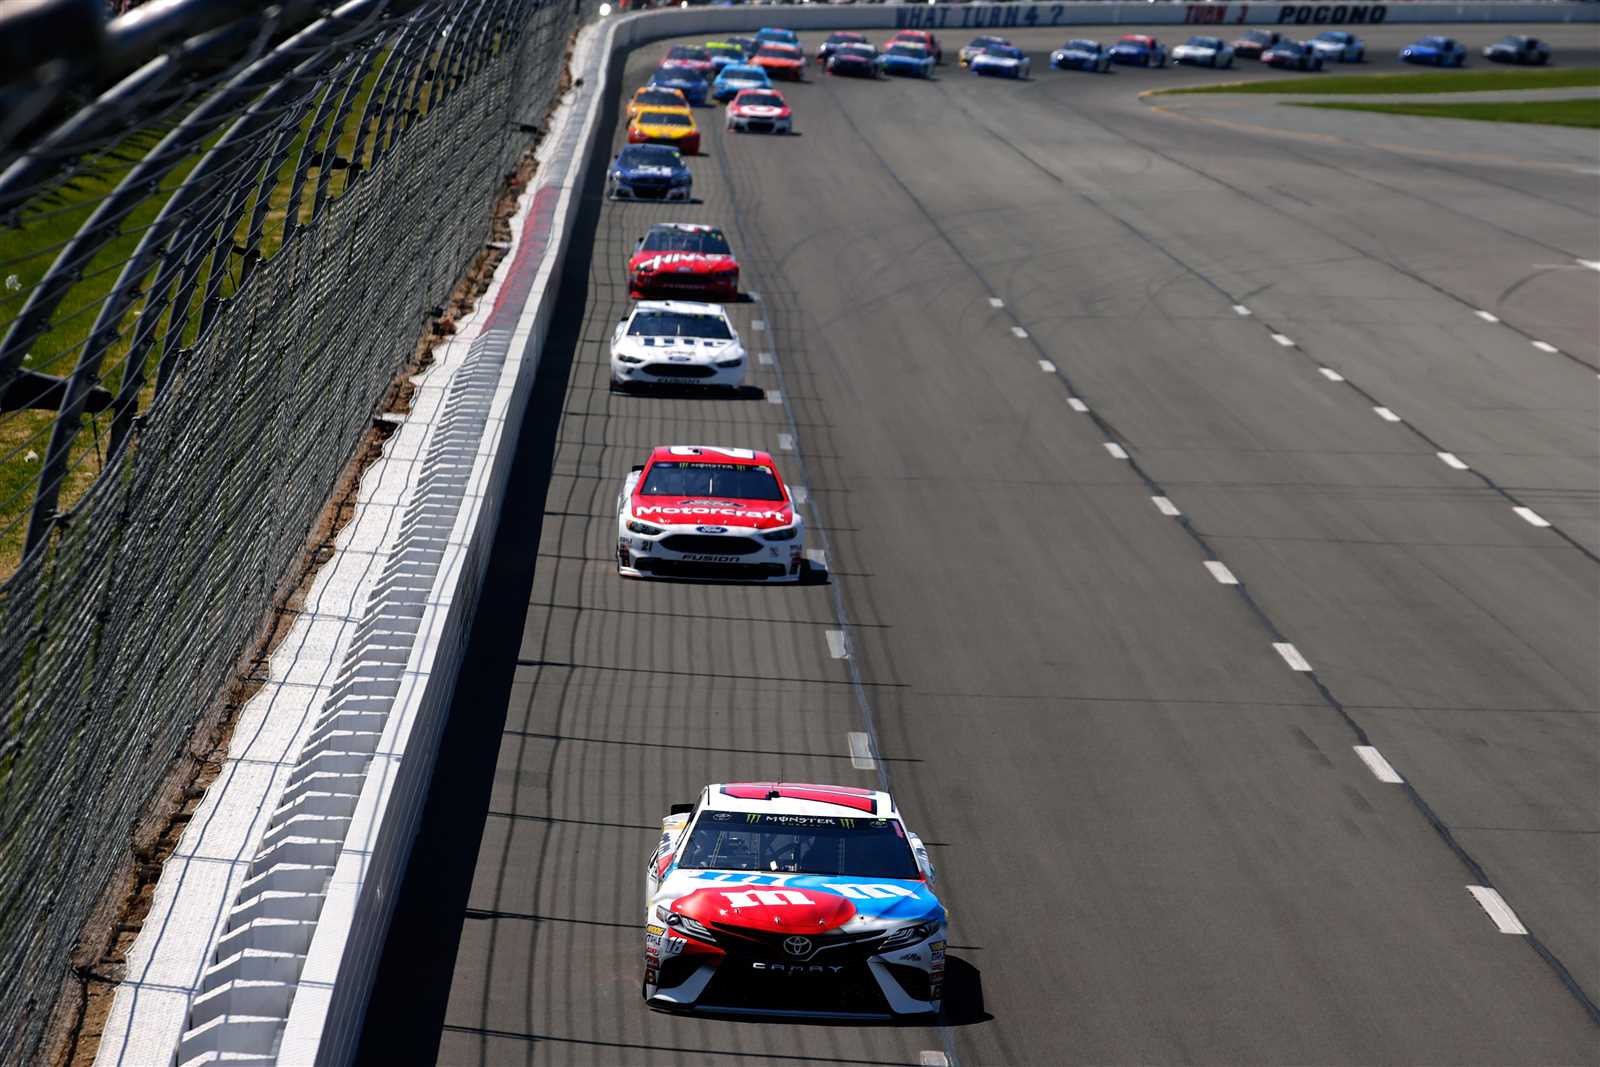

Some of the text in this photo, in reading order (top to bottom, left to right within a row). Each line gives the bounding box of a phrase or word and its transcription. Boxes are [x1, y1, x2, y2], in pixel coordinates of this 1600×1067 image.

[896, 6, 951, 28] WHAT
[961, 6, 1021, 28] TURN
[1277, 5, 1388, 24] POCONO
[636, 505, 785, 521] Motorcraft
[682, 554, 740, 562] FUSION
[765, 814, 836, 825] MONSTER
[752, 961, 844, 973] CAMRY
